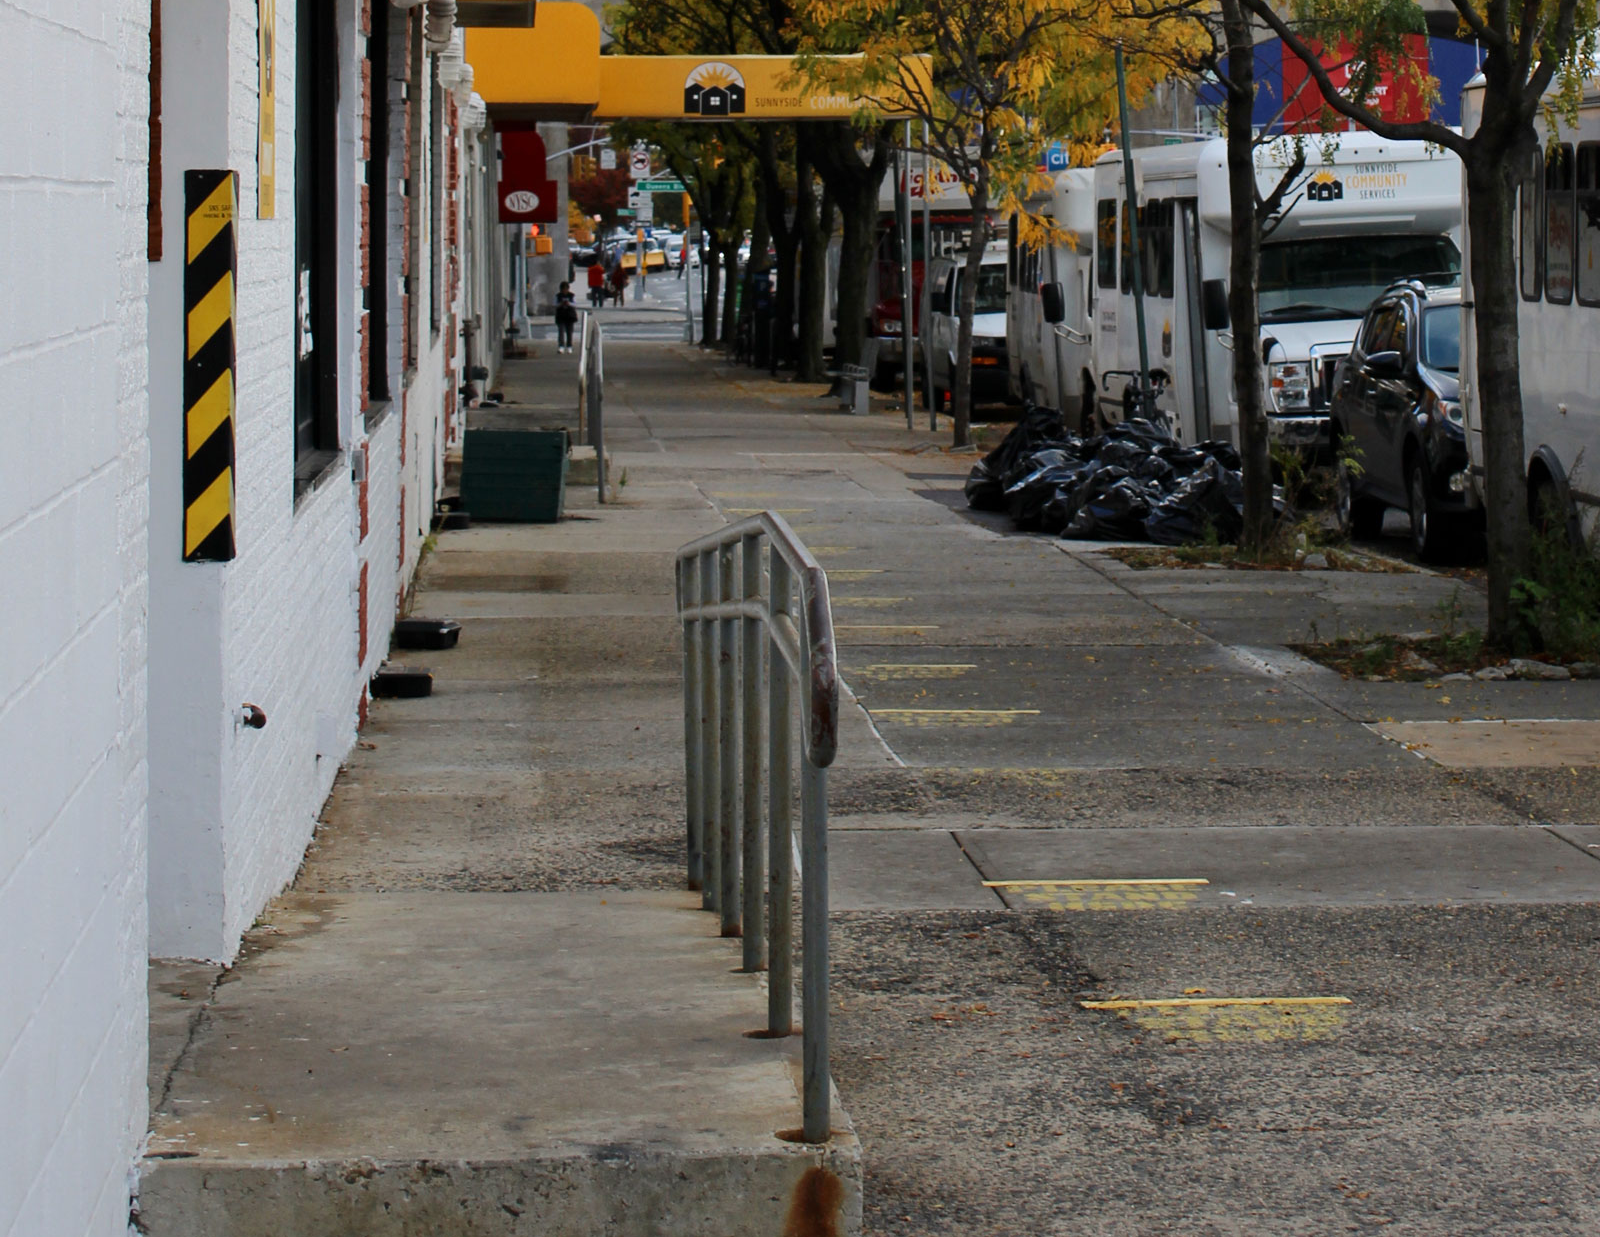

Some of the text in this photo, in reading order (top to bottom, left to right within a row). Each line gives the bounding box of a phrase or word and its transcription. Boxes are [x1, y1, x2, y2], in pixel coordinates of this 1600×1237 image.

[755, 97, 802, 107] SUNNYSIDE
[1051, 152, 1070, 164] cit
[1355, 163, 1398, 174] SUNNYSIDE
[1345, 173, 1407, 190] COMMUNITY
[1360, 189, 1396, 200] SERVICES
